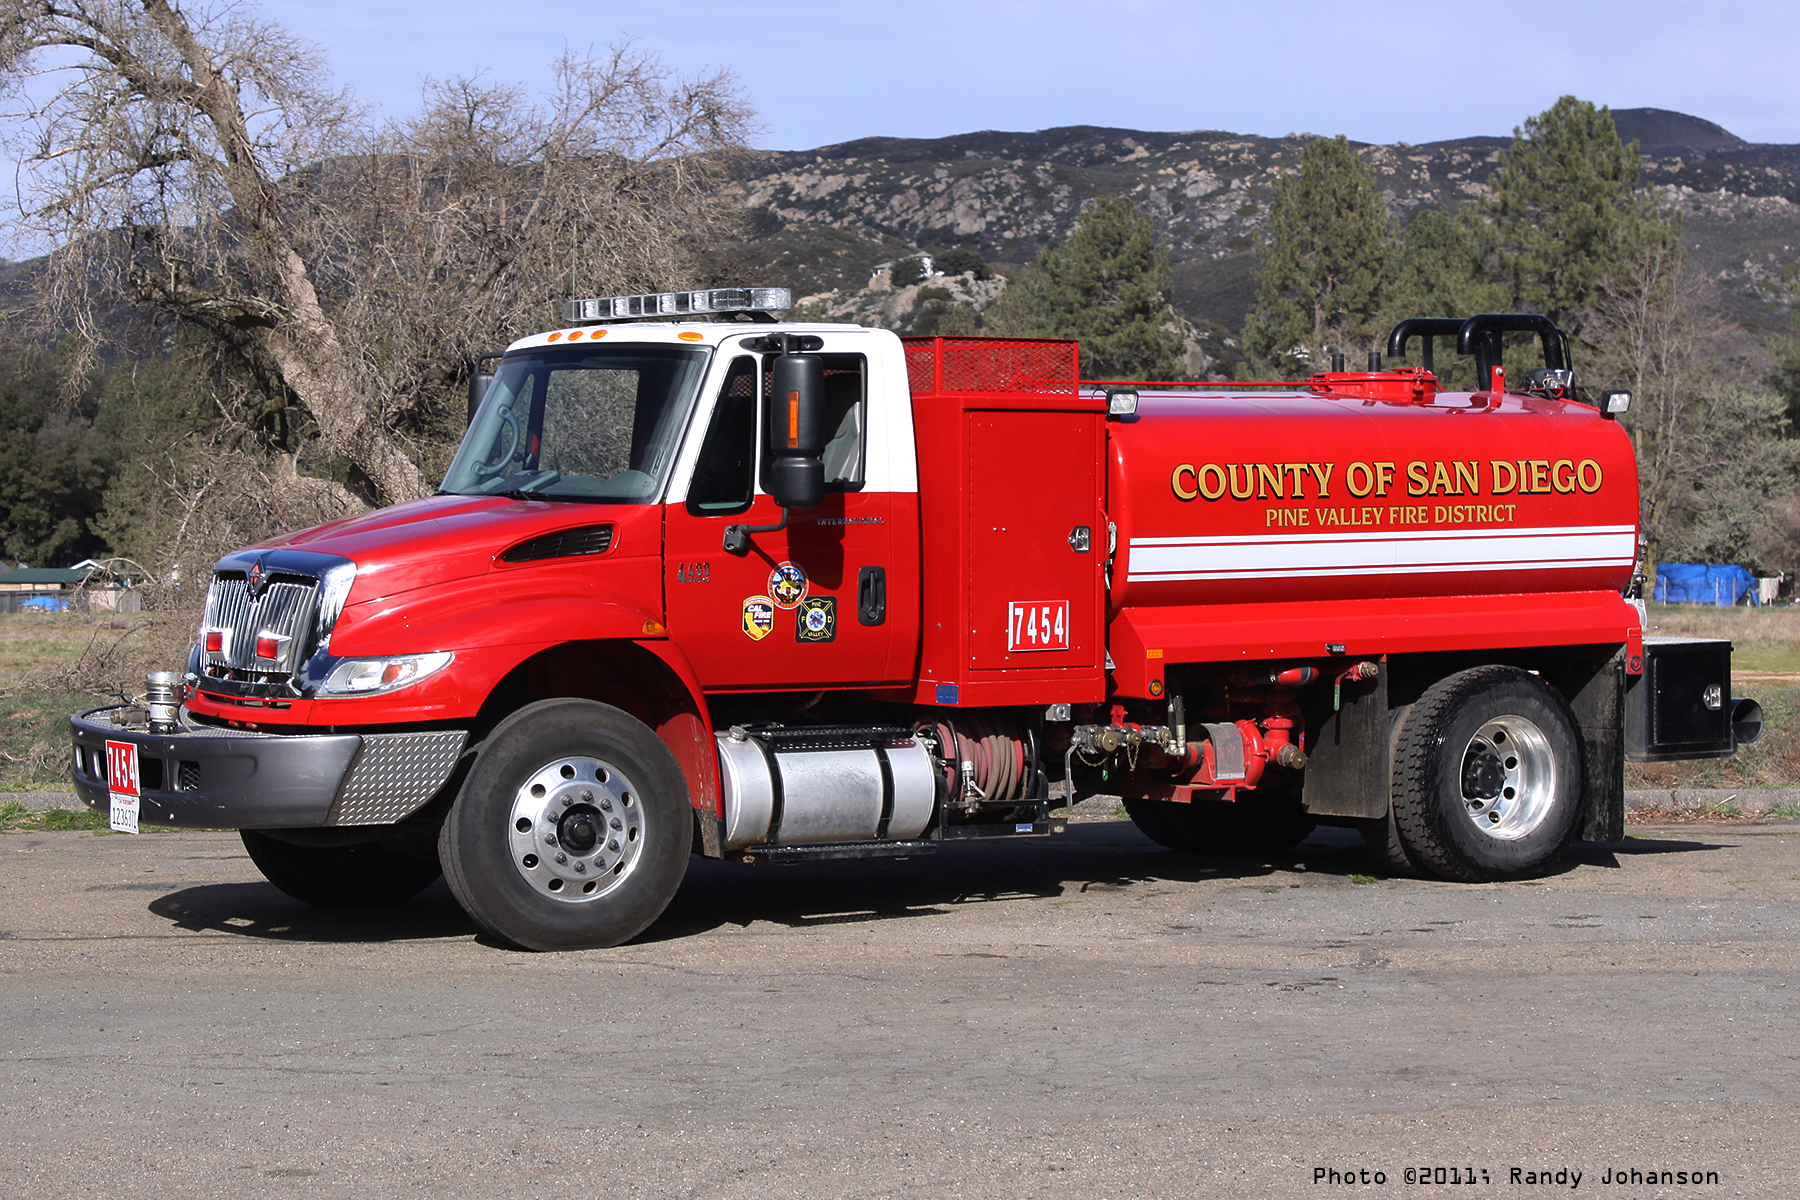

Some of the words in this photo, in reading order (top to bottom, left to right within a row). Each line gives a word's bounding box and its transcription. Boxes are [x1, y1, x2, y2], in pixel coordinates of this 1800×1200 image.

[1171, 462, 1335, 501] COUNTY
[1346, 461, 1396, 497] OF
[1407, 460, 1479, 496] SAN
[1490, 458, 1603, 495] DIEGO
[817, 517, 885, 526] INTERNATIONAL
[1265, 508, 1310, 527] PINE
[1315, 507, 1384, 526] VALLEY
[1388, 505, 1428, 525] FIRE
[1434, 504, 1517, 523] DISTRICT
[1015, 606, 1064, 645] 7454
[108, 747, 136, 789] 7454
